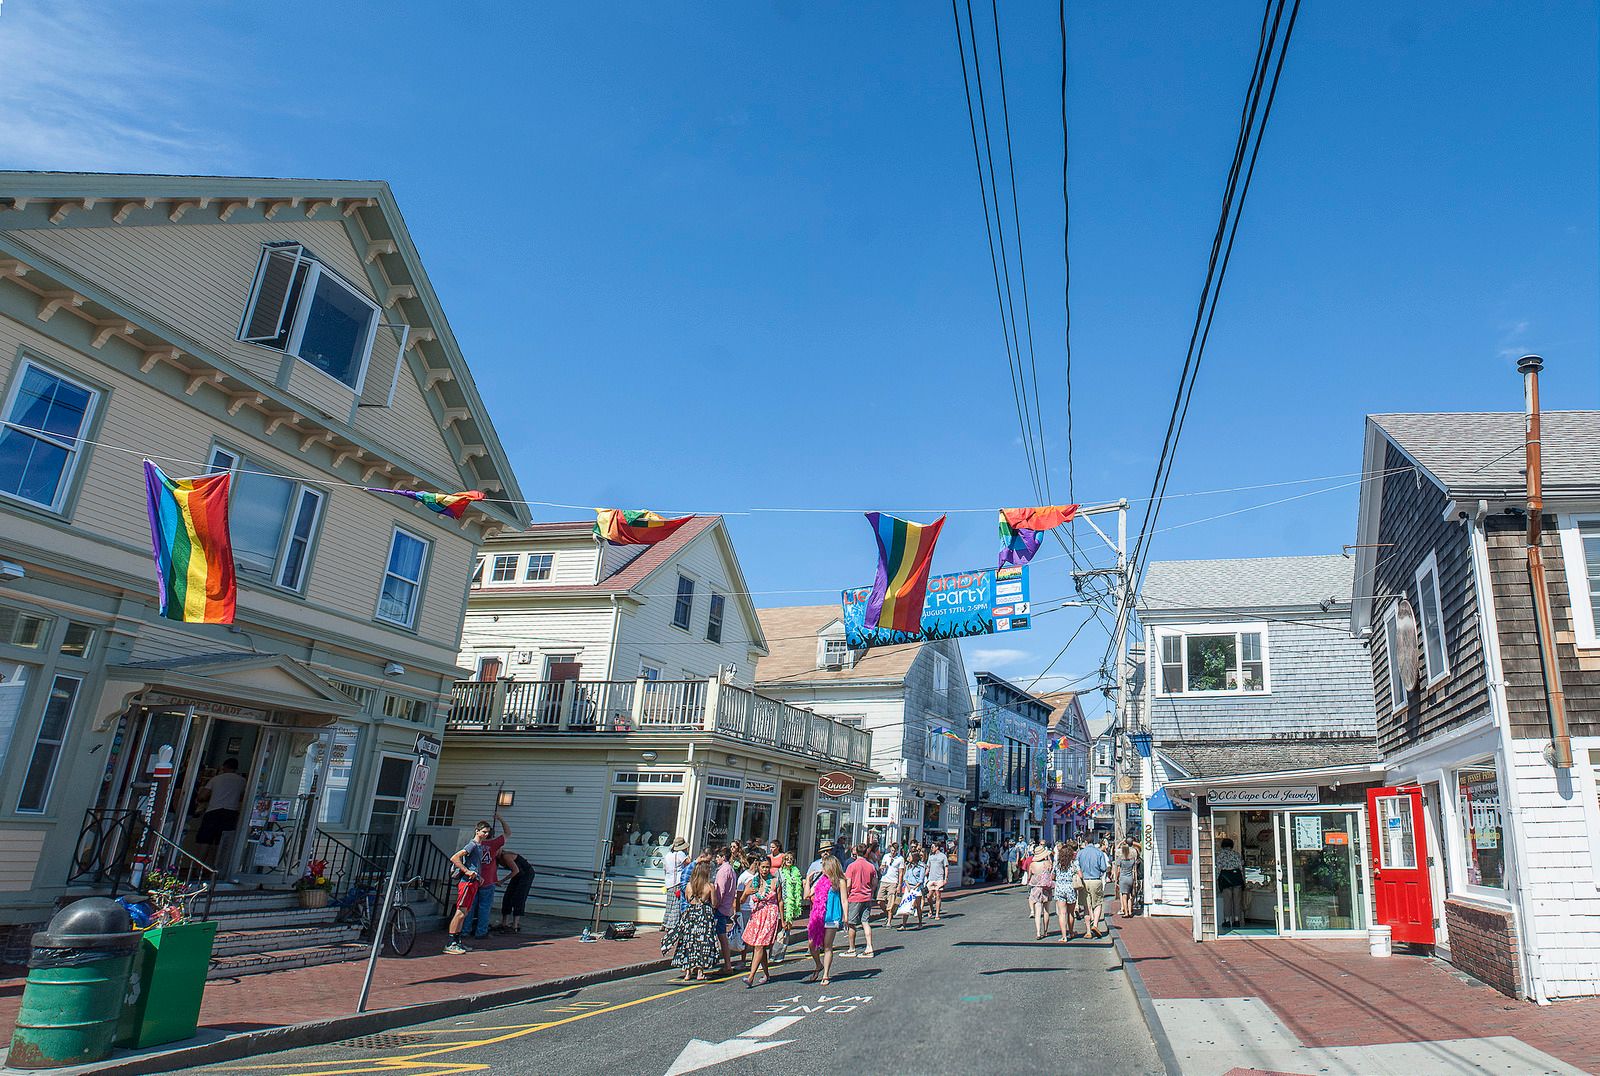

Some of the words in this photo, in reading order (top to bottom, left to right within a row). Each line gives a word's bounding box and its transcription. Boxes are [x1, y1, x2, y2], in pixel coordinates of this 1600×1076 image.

[967, 604, 988, 613] 2-5PM
[820, 776, 852, 792] Zinnia
[1238, 790, 1259, 801] Cape
[1262, 789, 1280, 800] Cod
[1281, 789, 1317, 801] Jewelry
